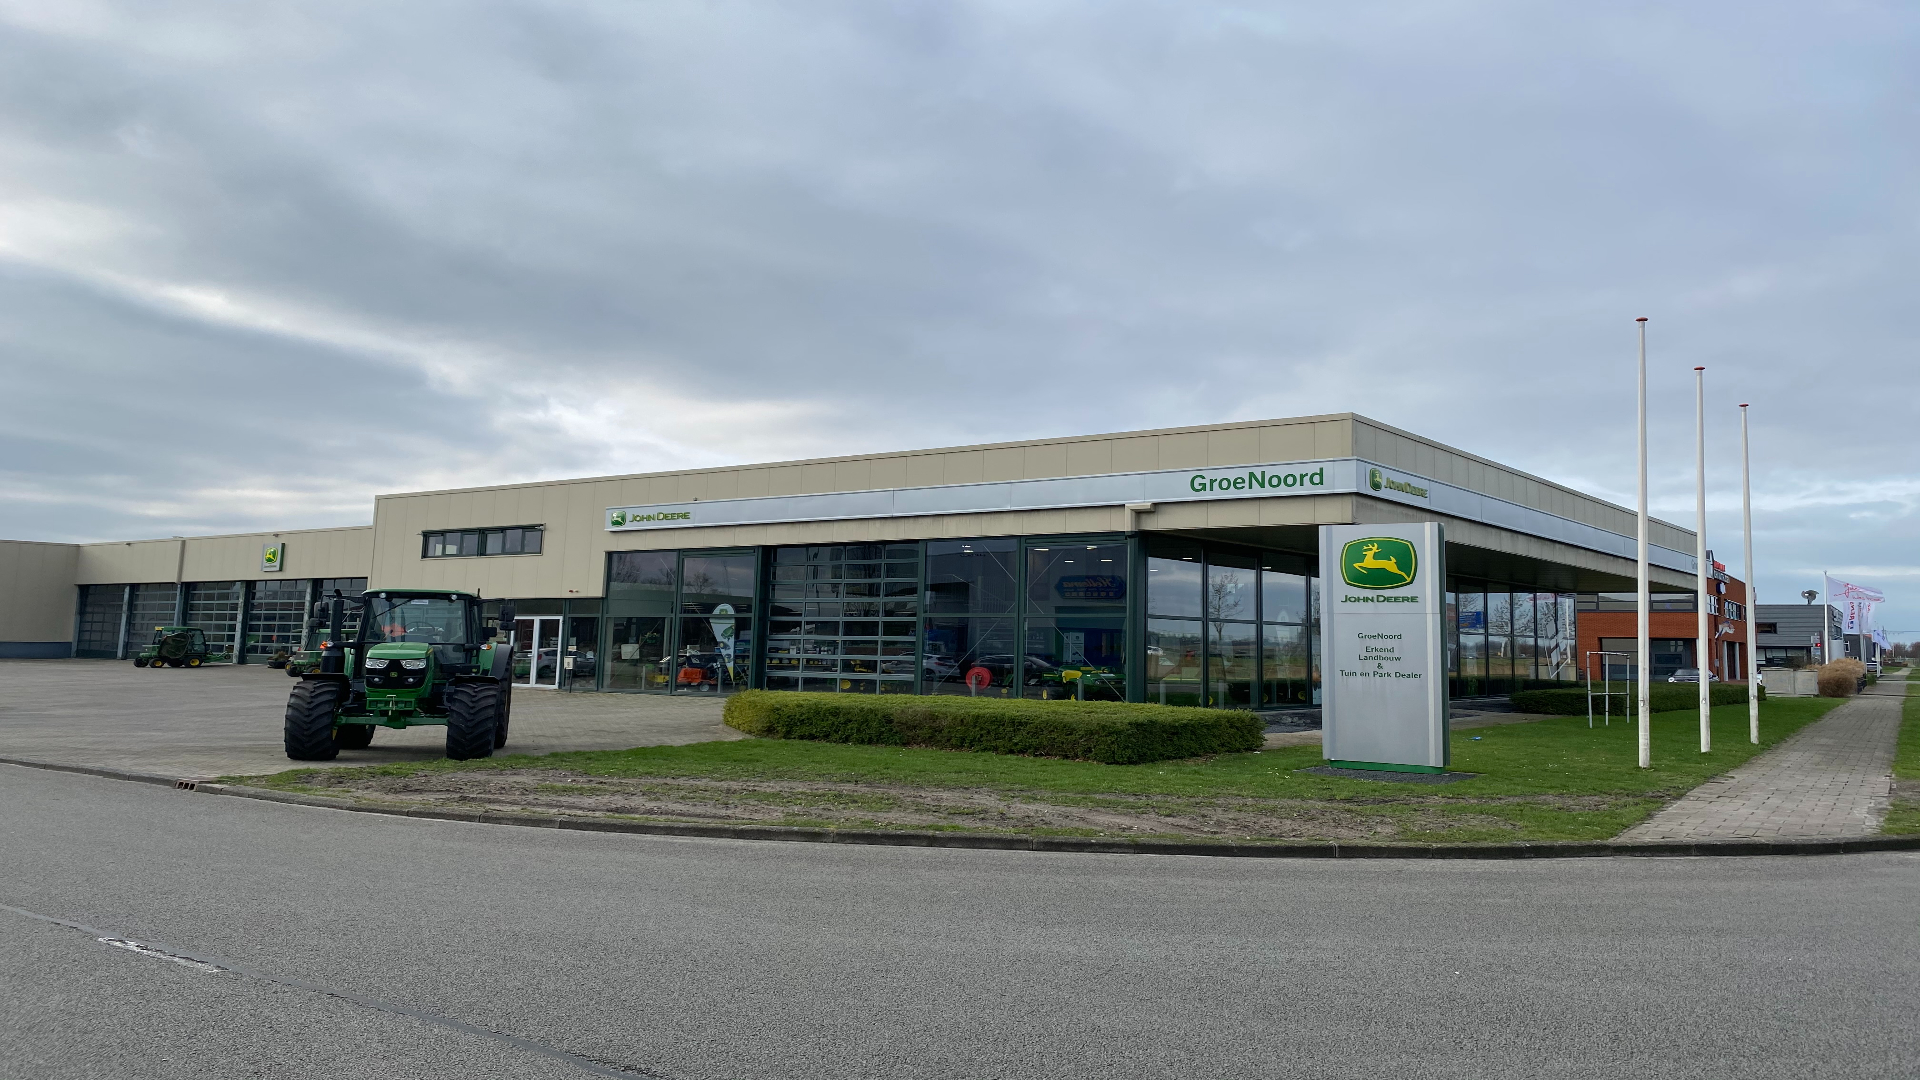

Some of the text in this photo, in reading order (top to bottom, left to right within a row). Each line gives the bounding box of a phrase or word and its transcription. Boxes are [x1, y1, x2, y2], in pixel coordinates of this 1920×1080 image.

[1190, 467, 1324, 492] GroeNoord
[1384, 477, 1404, 492] JOHN
[629, 512, 691, 522] JOHN DEERE
[1341, 594, 1419, 603] JOHN DEERE
[1357, 632, 1402, 640] GroeNoord
[1339, 669, 1357, 677] Tuin
[1394, 671, 1423, 679] Dealer
